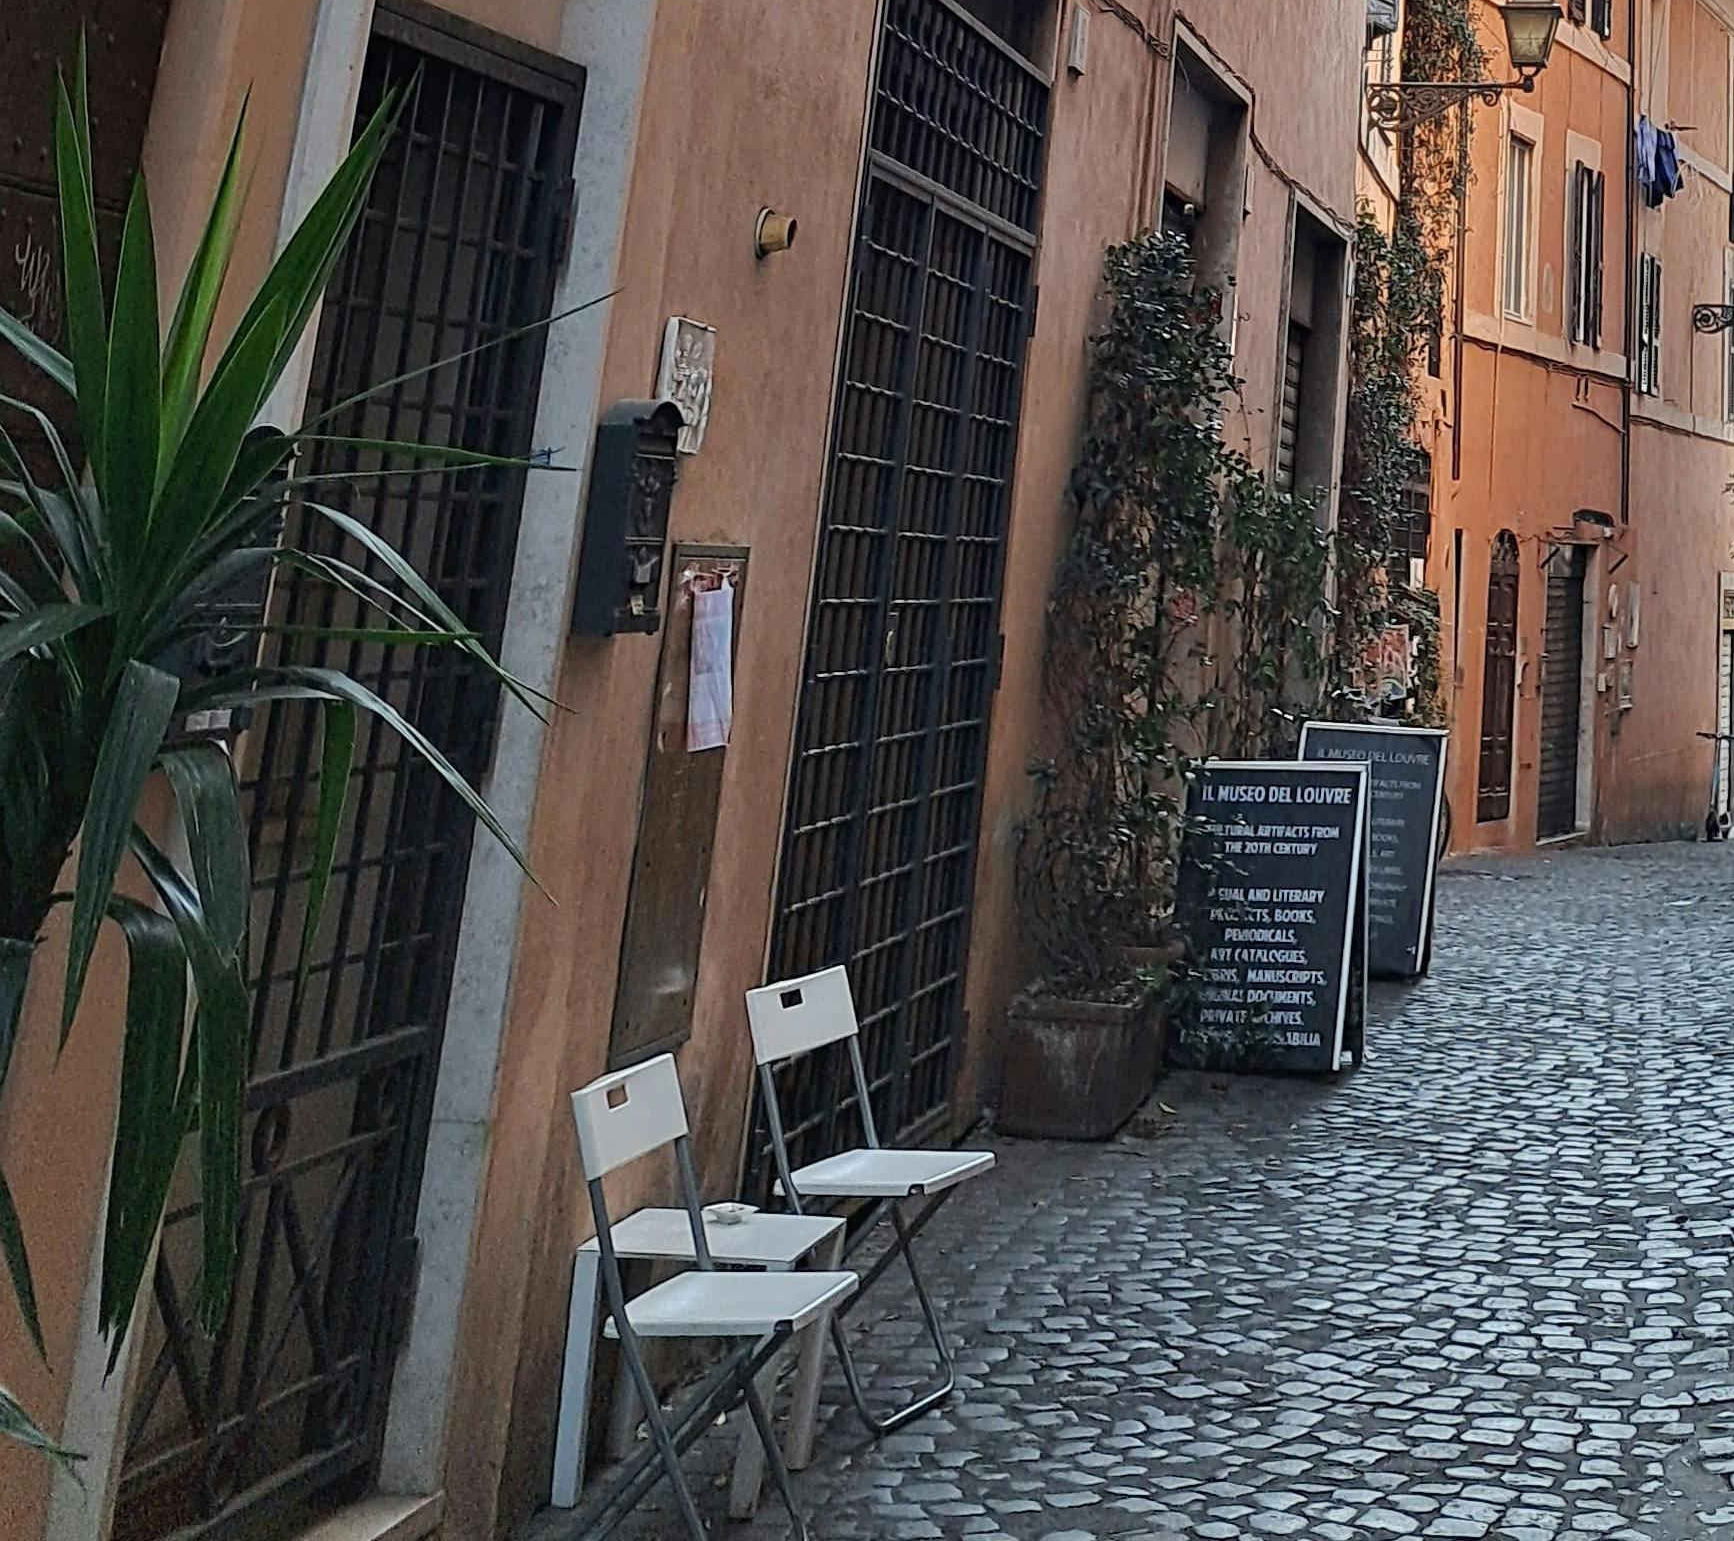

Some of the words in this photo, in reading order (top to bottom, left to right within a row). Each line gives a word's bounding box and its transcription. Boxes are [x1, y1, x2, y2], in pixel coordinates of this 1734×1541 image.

[1327, 748, 1366, 760] MUSEO
[1367, 751, 1388, 763] DEL
[1389, 752, 1431, 765] LOUVRE
[1202, 785, 1214, 801] IL
[1217, 785, 1266, 802] MUSEO
[1268, 786, 1293, 803] DEL
[1295, 786, 1352, 804] LOUVRE
[1256, 825, 1310, 839] ARTIFACTS
[1311, 826, 1340, 839] FROM
[1224, 841, 1243, 854] THE
[1244, 842, 1271, 855] 20TH
[1272, 843, 1319, 856] CENTURY
[1247, 888, 1271, 902] AND
[1272, 889, 1325, 903] LITERARY
[1273, 909, 1317, 924] BOOKS,
[1223, 927, 1298, 944] PERIODICALS,
[1209, 947, 1233, 962] ART
[1234, 948, 1309, 965] CATALOGUES,
[1246, 969, 1328, 986] MANUSCRIPTS,
[1246, 989, 1317, 1006] DOCUMENTS,
[1199, 1008, 1249, 1024] PRIVATE
